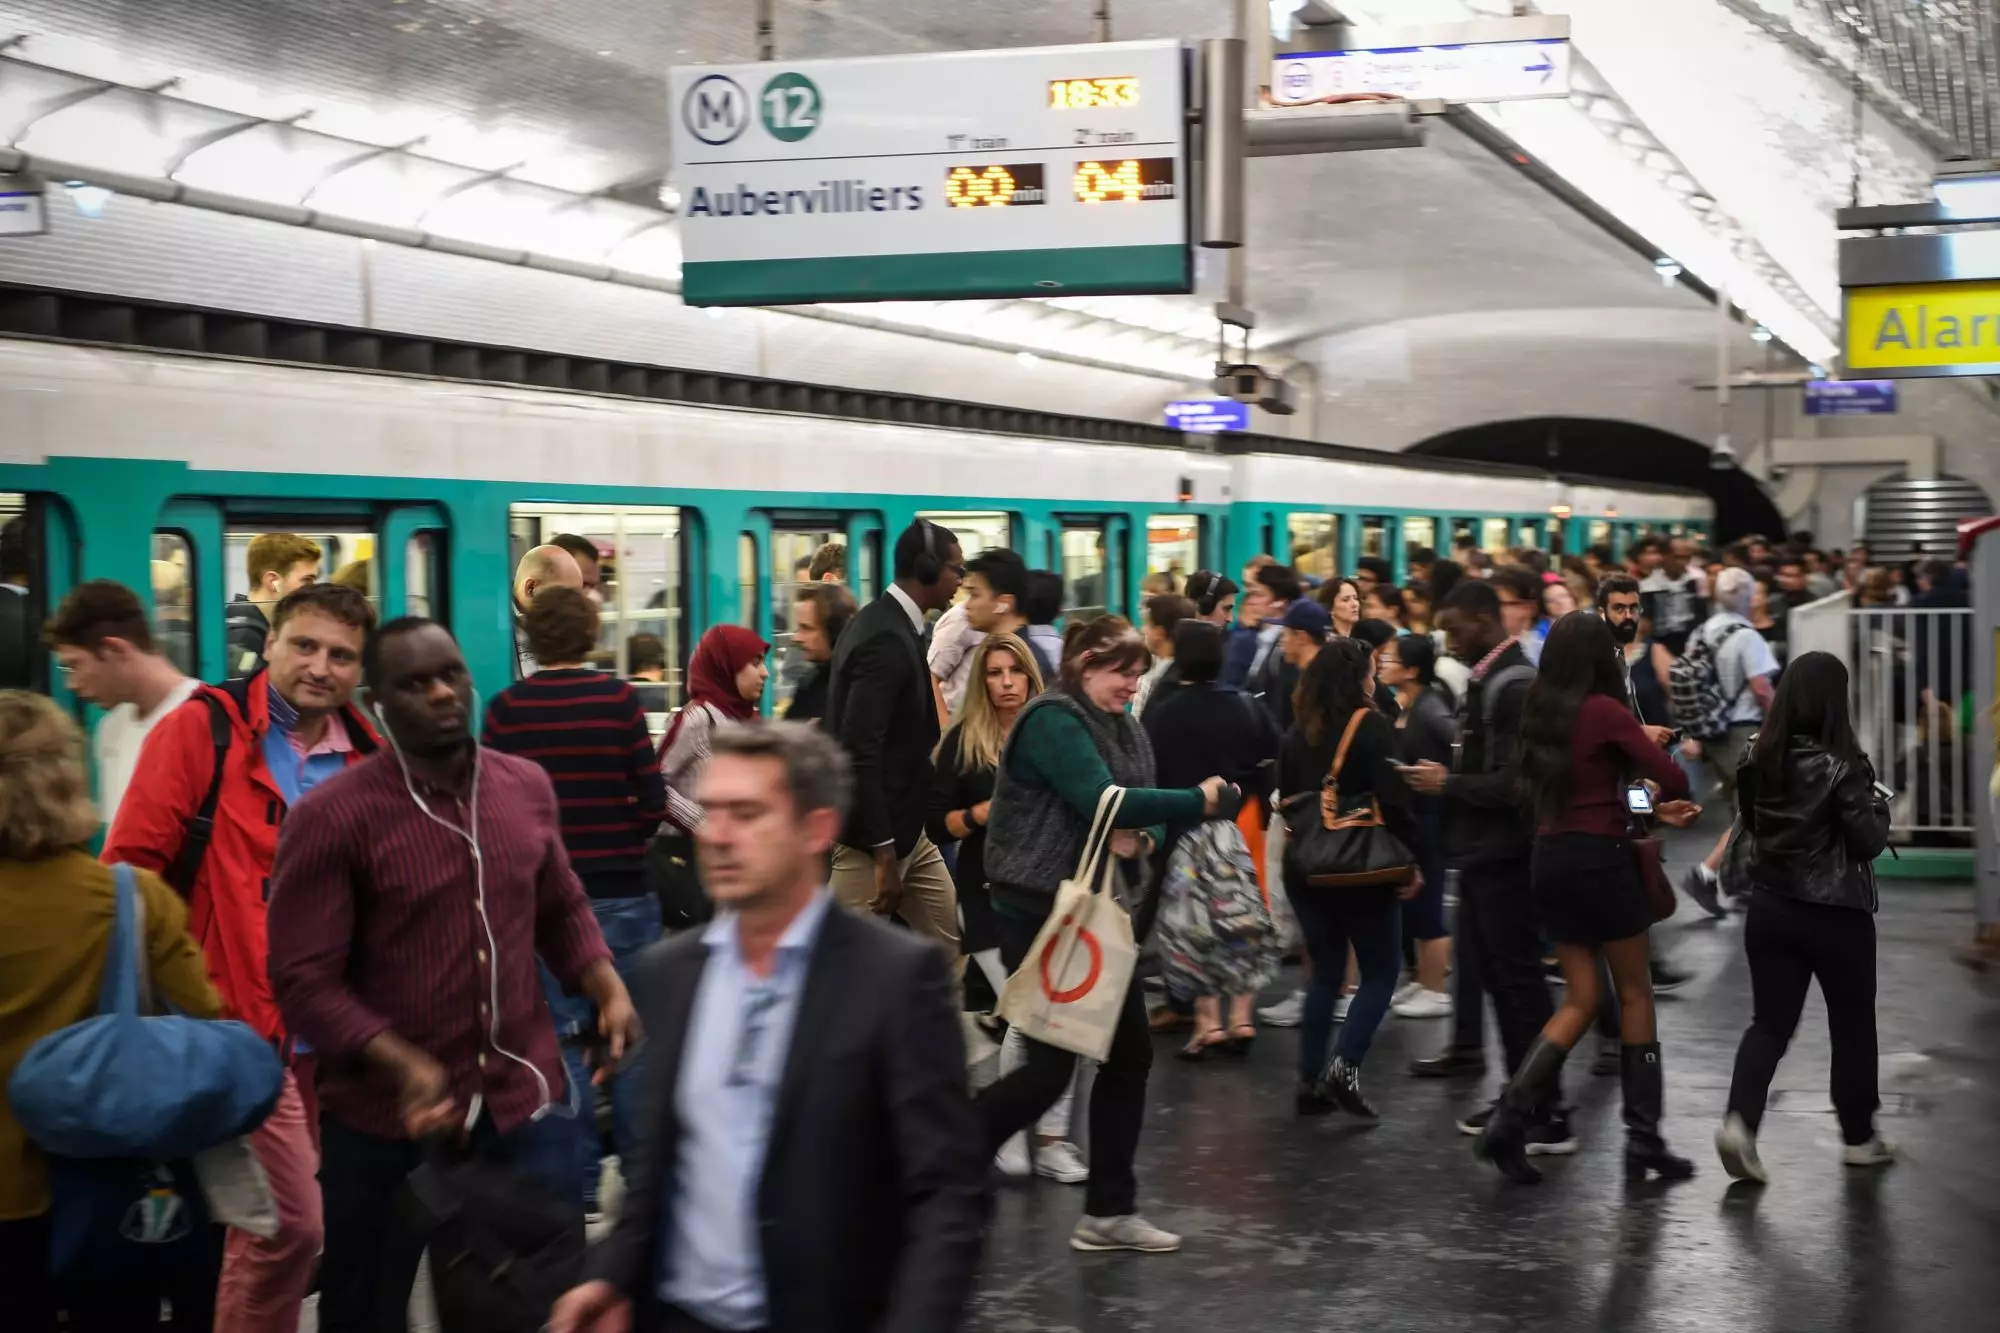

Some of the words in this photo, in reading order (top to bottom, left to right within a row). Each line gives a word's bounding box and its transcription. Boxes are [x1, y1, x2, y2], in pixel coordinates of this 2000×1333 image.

[697, 90, 736, 129] M
[763, 86, 816, 129] 12
[1051, 78, 1139, 109] 18:33
[686, 179, 923, 218] Aubervilliers
[945, 165, 1015, 208] 00
[1073, 160, 1143, 204] 04
[1871, 304, 2000, 351] Alar
